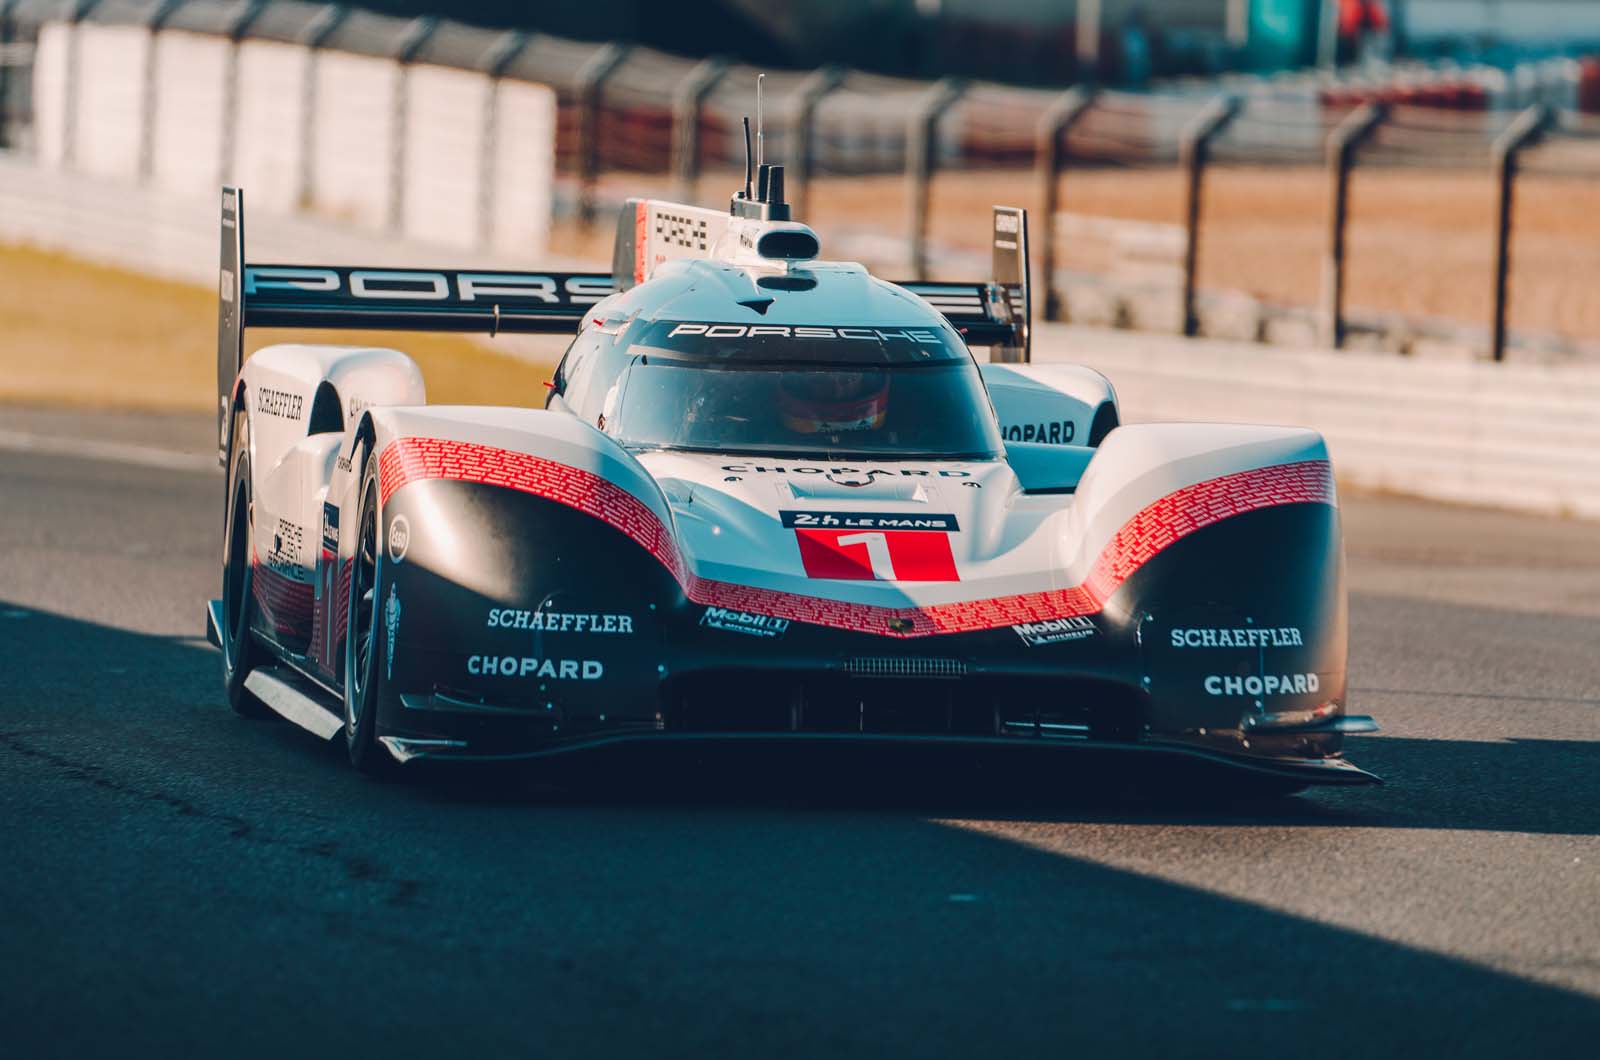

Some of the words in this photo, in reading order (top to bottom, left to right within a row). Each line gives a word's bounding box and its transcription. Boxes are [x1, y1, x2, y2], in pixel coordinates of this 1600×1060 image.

[667, 324, 942, 344] PORSCHE
[258, 387, 303, 421] SCHAEFFLER
[721, 465, 972, 478] CHOPARD
[845, 518, 874, 527] LE
[878, 518, 947, 529] MANS
[837, 532, 897, 580] 1
[487, 609, 633, 633] SCHAEFFLER
[705, 606, 767, 627] Mobil
[1012, 618, 1073, 636] Mobil
[1171, 627, 1303, 647] SCHAEFFLER
[467, 655, 604, 680] CHOPARD
[1204, 674, 1319, 695] CHOPARD
